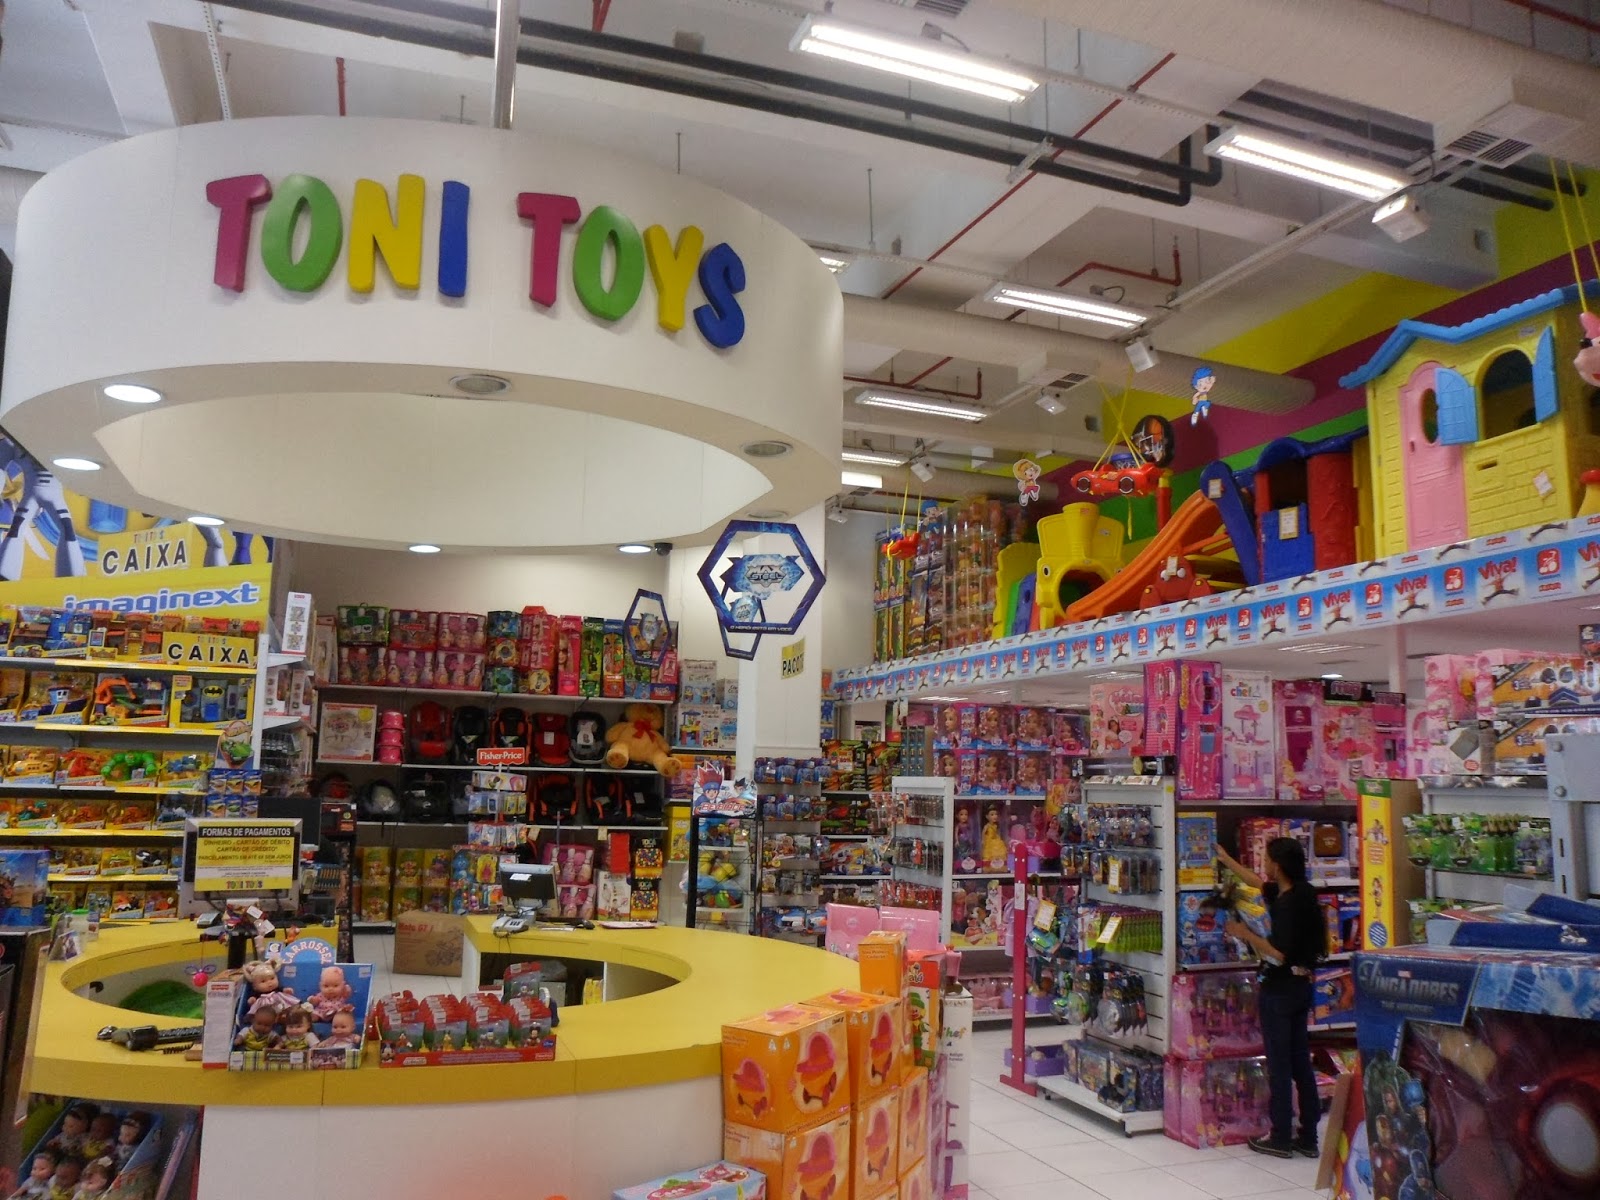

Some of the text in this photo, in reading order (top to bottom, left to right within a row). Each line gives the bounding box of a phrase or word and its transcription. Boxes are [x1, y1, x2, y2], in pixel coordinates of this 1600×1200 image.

[206, 173, 746, 349] TONI TOYS
[102, 540, 186, 575] CAIXA
[750, 572, 784, 580] STEEL
[1478, 557, 1518, 579] Viva!
[1394, 575, 1427, 595] Viva!
[65, 583, 258, 613] imaginext
[1322, 589, 1352, 608] Viva!
[1260, 602, 1286, 619] Viva!
[1154, 623, 1176, 638] Viva!
[1204, 613, 1228, 629] Viva!
[1110, 631, 1129, 645] Viva!
[168, 643, 249, 665] CAIXA
[480, 751, 522, 760] Fisher-Price
[202, 828, 291, 836] FORMAS DE PAGAMENTOS
[282, 941, 332, 965] CARROSSEL
